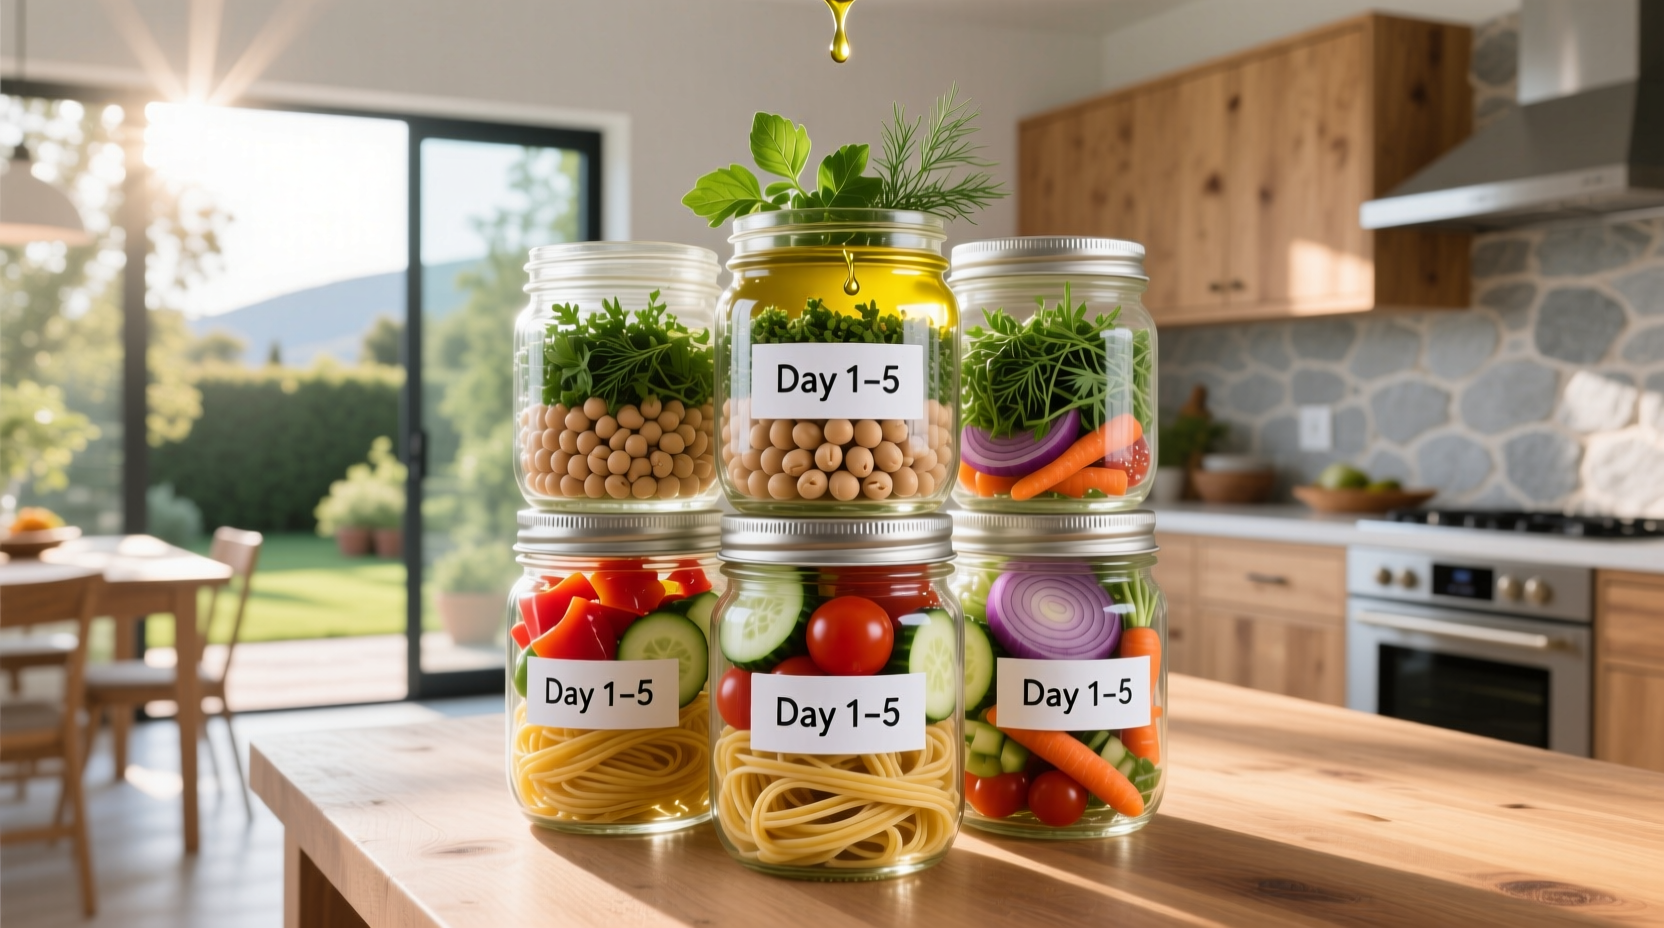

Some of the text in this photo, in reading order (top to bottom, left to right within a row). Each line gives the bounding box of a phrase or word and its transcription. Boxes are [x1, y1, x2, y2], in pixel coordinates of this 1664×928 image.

[777, 363, 837, 401] Day
[545, 677, 594, 714] Day
[1023, 678, 1079, 714] Day
[776, 696, 836, 736] Day
